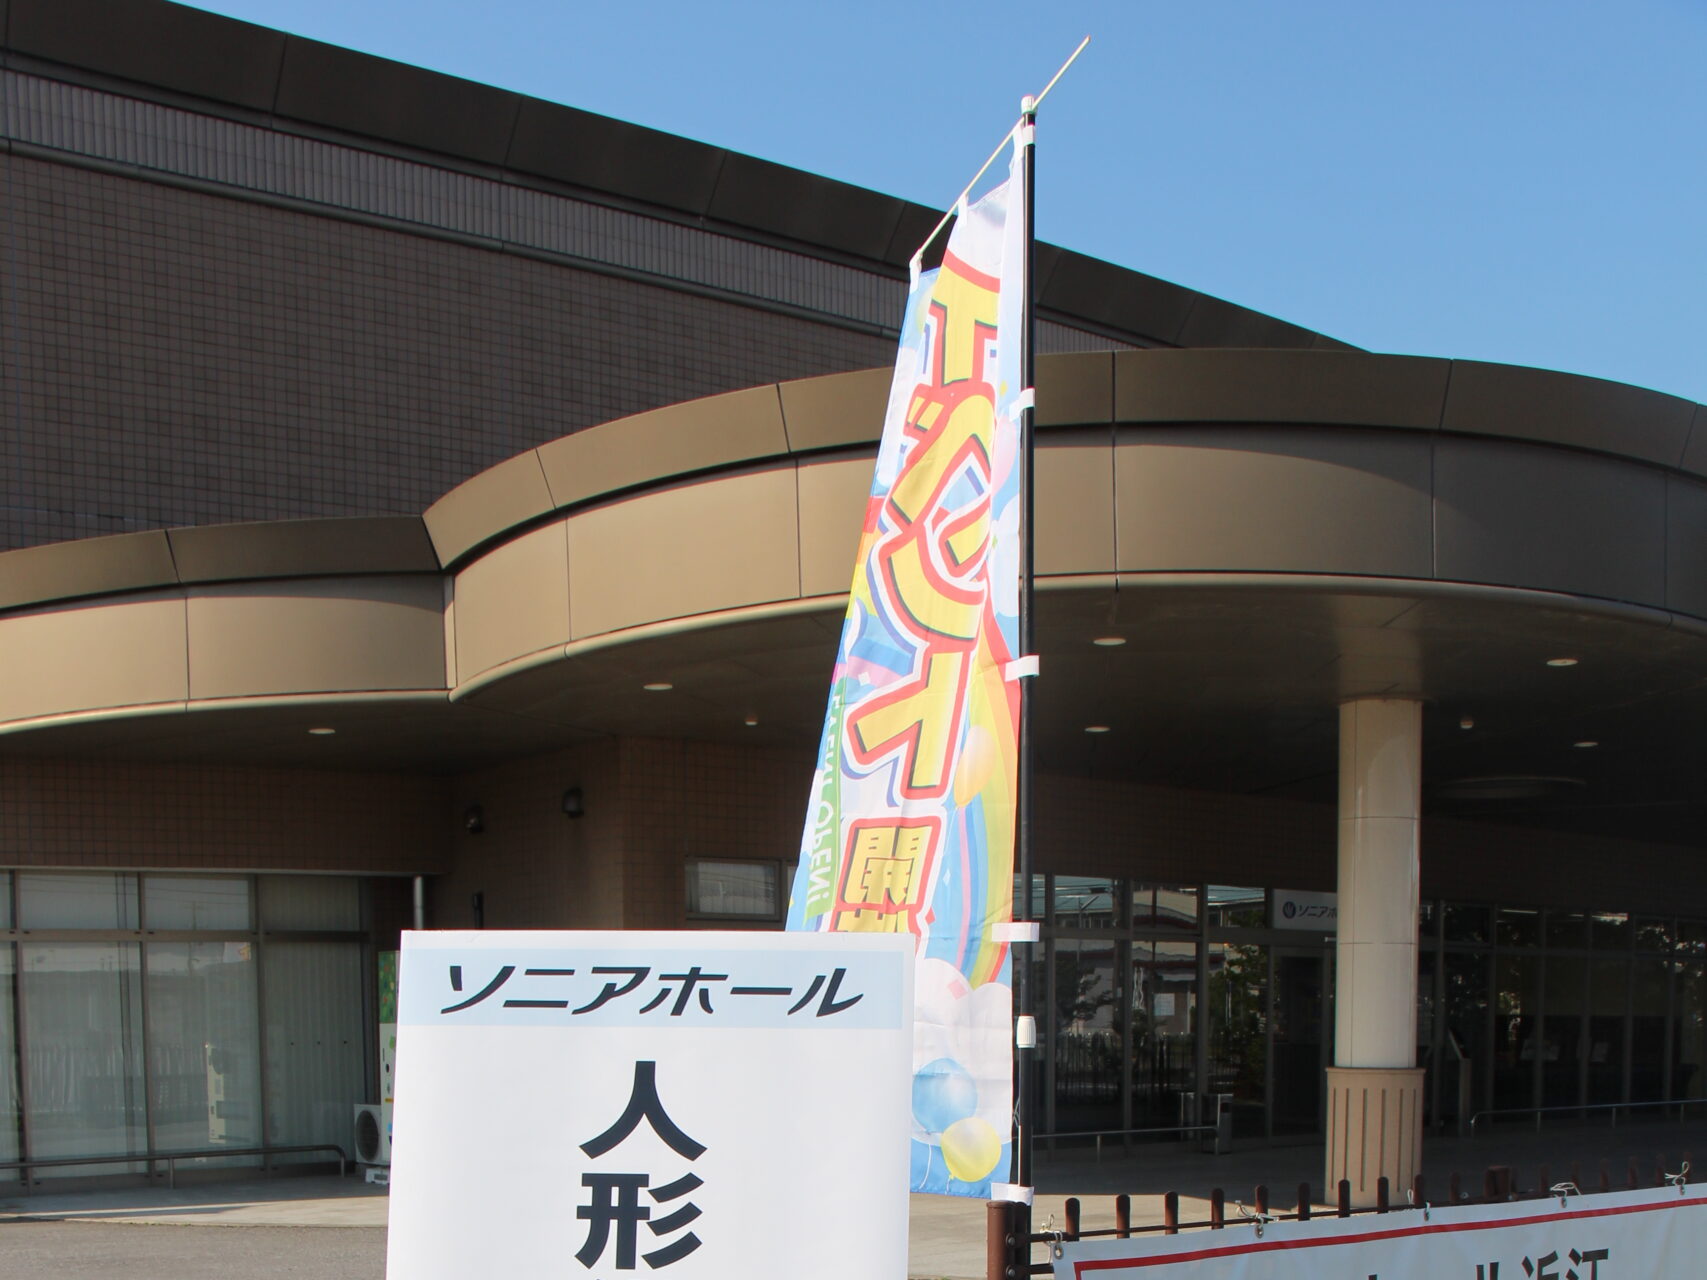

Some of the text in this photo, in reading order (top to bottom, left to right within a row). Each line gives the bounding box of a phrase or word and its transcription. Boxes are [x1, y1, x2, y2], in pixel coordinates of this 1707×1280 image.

[440, 965, 864, 1018] ソニアホール
